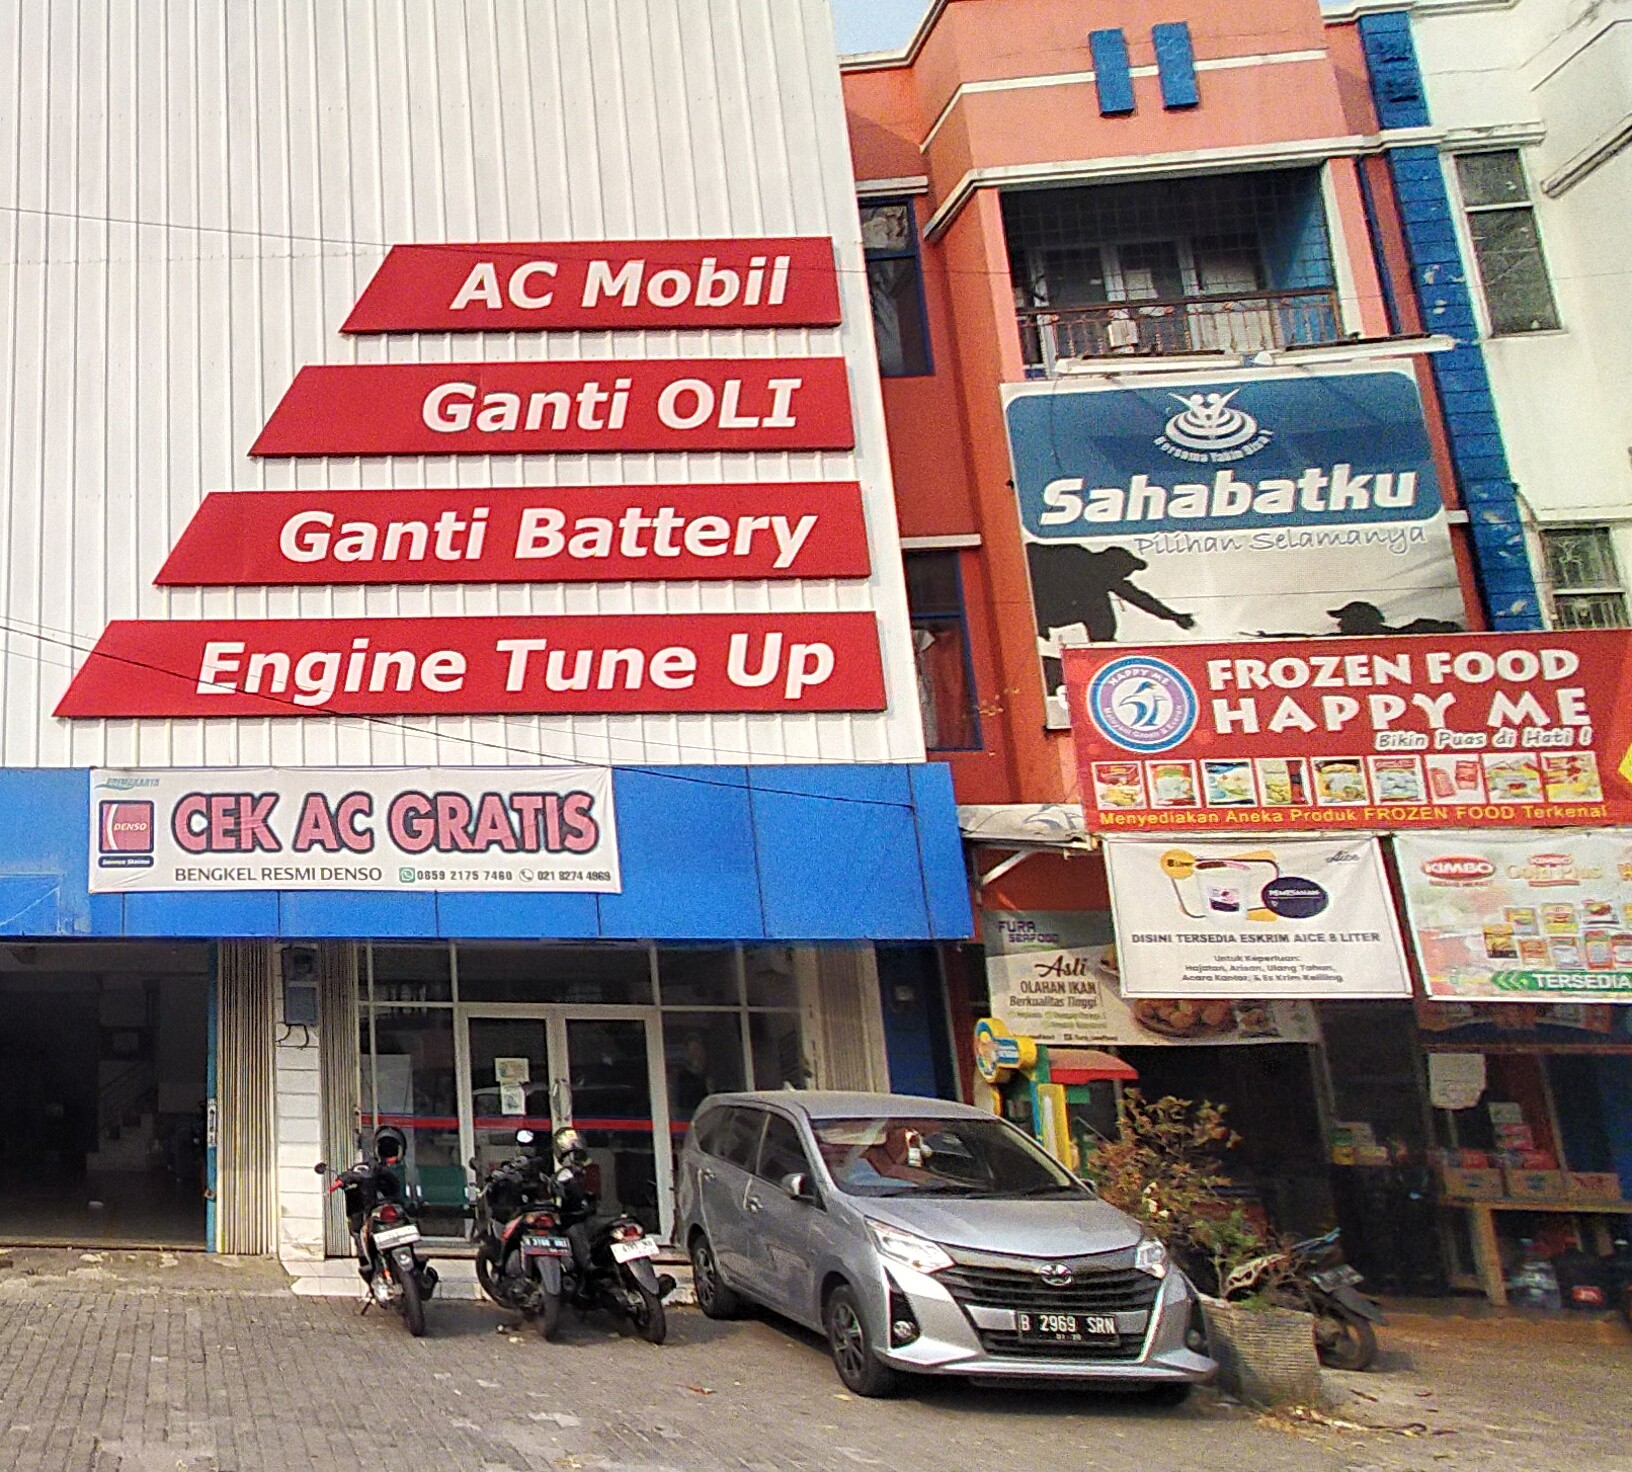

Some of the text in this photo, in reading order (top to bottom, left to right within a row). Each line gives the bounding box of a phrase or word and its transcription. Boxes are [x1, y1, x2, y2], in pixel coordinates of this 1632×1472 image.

[451, 257, 790, 310] AC Mobil
[421, 377, 803, 432] Ganti OLI
[1040, 464, 1419, 525] Sahabatku
[279, 504, 818, 569] Ganti Battery
[1134, 526, 1426, 555] Pilihan Selamanya
[195, 632, 835, 705] Engine Tune Up
[1108, 669, 1148, 686] HAPPY
[1207, 649, 1580, 691] FROZEN FOOD
[1211, 688, 1592, 735] HAPPY ME
[1377, 733, 1427, 748] Bikin
[1437, 731, 1485, 746] Puas
[1494, 729, 1515, 746] di
[1525, 728, 1572, 745] Hati
[170, 790, 600, 855] CEK AC GRATIS
[1100, 804, 1608, 827] Menyediakan Aneka Produk FROZEN FOOD Terkenal
[113, 822, 148, 831] DENSO
[175, 867, 256, 881] BENGKEL
[261, 867, 316, 881] RESMI
[320, 867, 382, 881] DENSO
[417, 870, 445, 880] 0859
[450, 870, 480, 880] 2175
[537, 871, 555, 880] 021
[558, 871, 583, 881] 8274
[1425, 862, 1494, 874] KIMBO
[998, 920, 1036, 933] FURA
[1131, 933, 1172, 943] DISINI
[1176, 933, 1237, 943] TERSEDIA
[1240, 933, 1289, 943] ESKRIM
[1294, 933, 1326, 942] AICE
[1339, 932, 1380, 942] LITER
[1034, 955, 1088, 977] Asli
[1020, 981, 1097, 994] OLAHAN IKAN
[1532, 973, 1632, 988] TERSEDIA
[1009, 996, 1064, 1007] Berkualitas
[1020, 1314, 1116, 1334] B 2969 SRN
